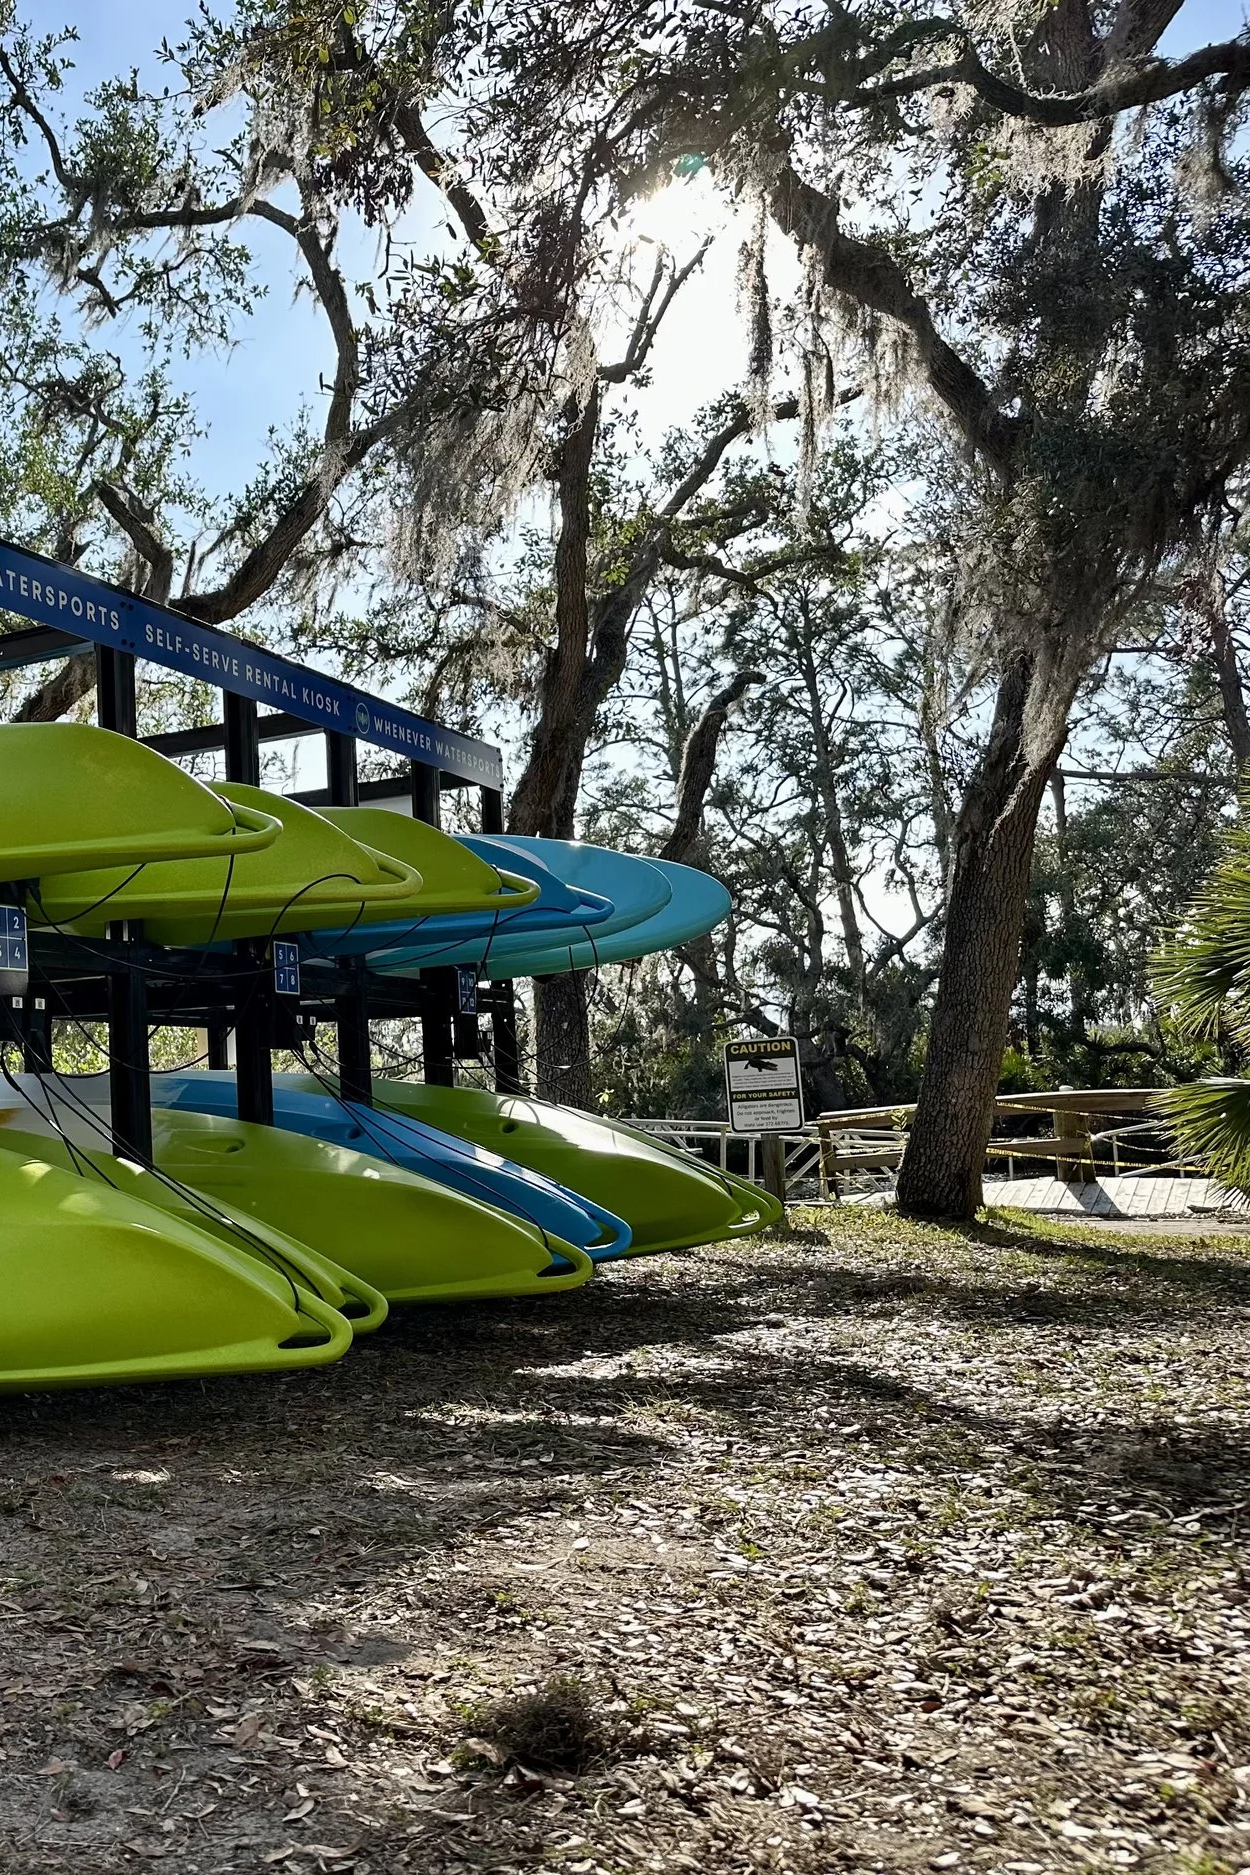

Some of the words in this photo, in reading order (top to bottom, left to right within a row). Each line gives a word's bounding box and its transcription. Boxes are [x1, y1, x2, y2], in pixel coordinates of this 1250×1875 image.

[145, 623, 239, 677] SELF-SERVE
[245, 664, 297, 700] RENTAL
[302, 686, 340, 716] KIOSK
[373, 715, 432, 751] WHENEVER
[435, 739, 501, 779] WATERSPORTS
[13, 916, 20, 929] 2
[14, 947, 21, 960] 4
[278, 950, 283, 960] 5
[290, 952, 294, 961] 6
[280, 974, 284, 984] 7
[291, 975, 296, 985] 8
[730, 1041, 791, 1054] CAUTION
[748, 1091, 767, 1099] YOUR
[769, 1090, 796, 1098] SAFETY
